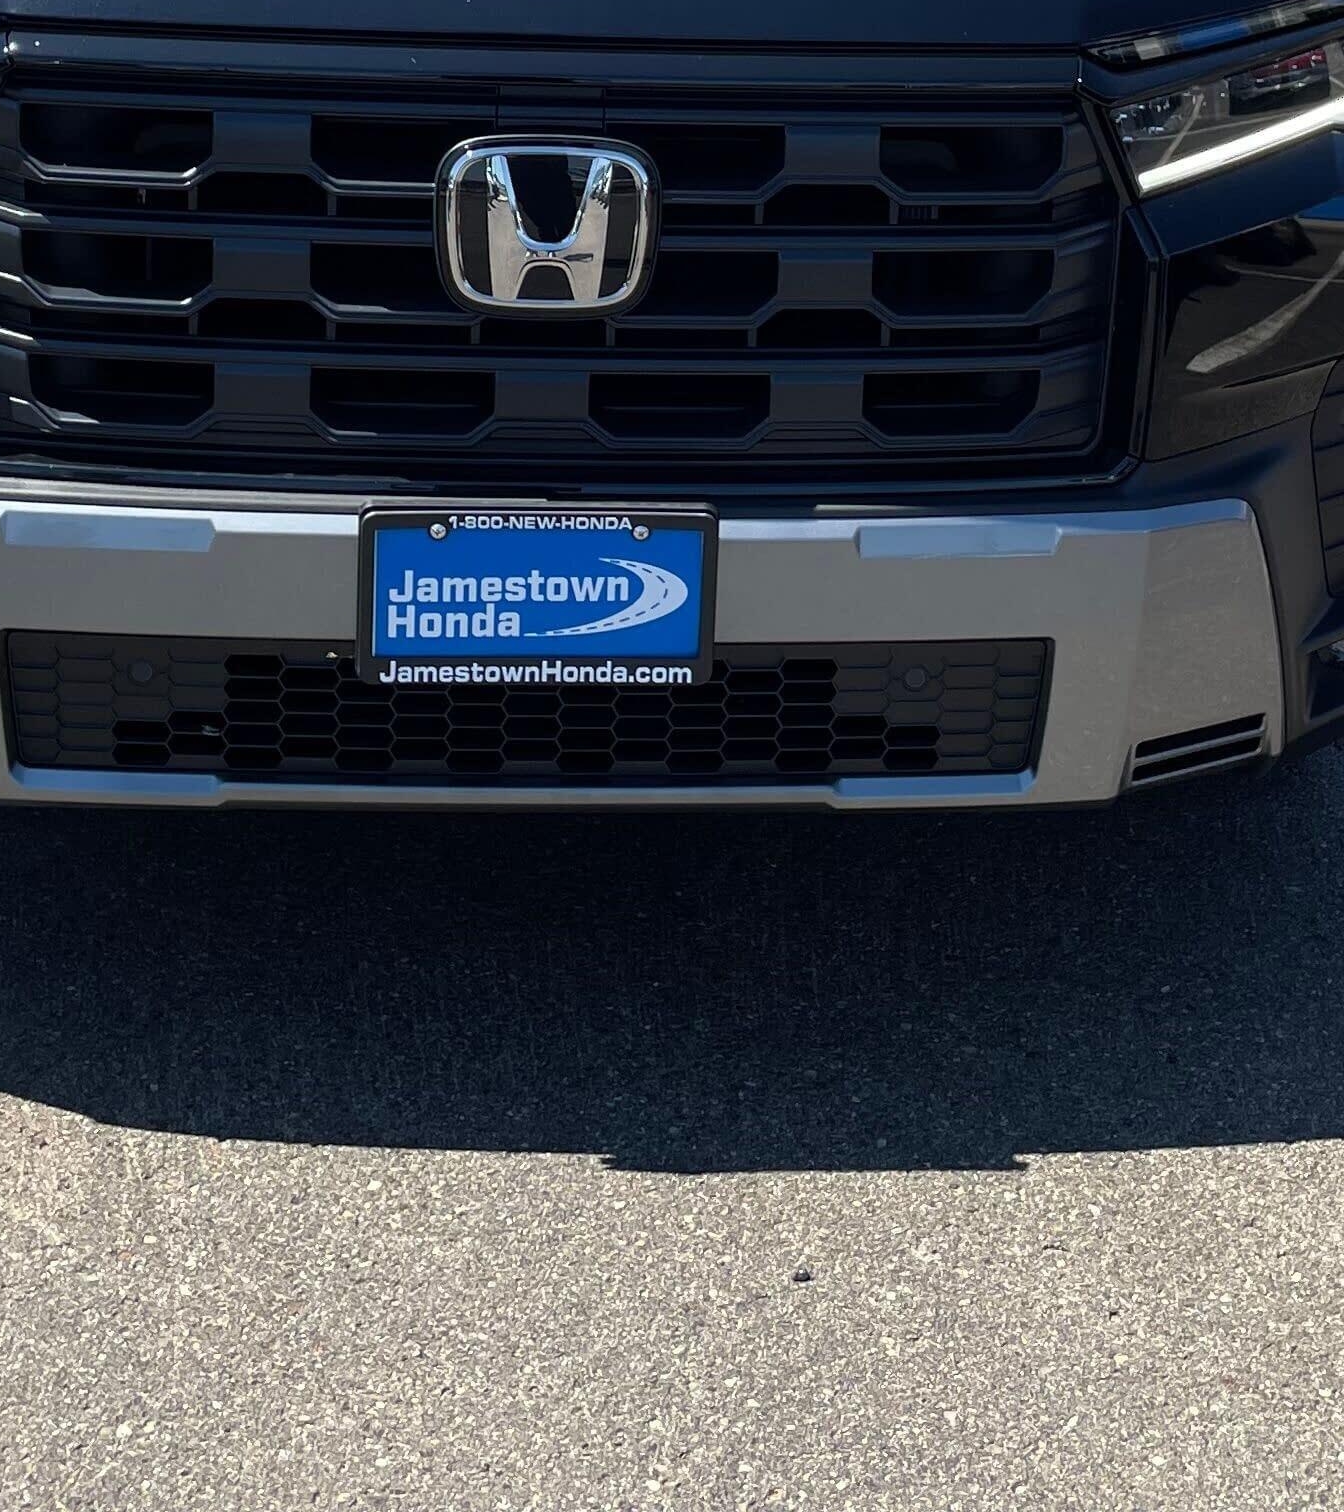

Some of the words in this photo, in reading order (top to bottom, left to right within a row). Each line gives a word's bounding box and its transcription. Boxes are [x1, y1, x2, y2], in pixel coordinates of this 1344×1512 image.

[448, 515, 633, 531] 1-800-NEW-HONDA
[388, 569, 630, 603] Jamestown
[387, 603, 521, 638] Honda
[379, 660, 693, 684] JamestownHonda.com
